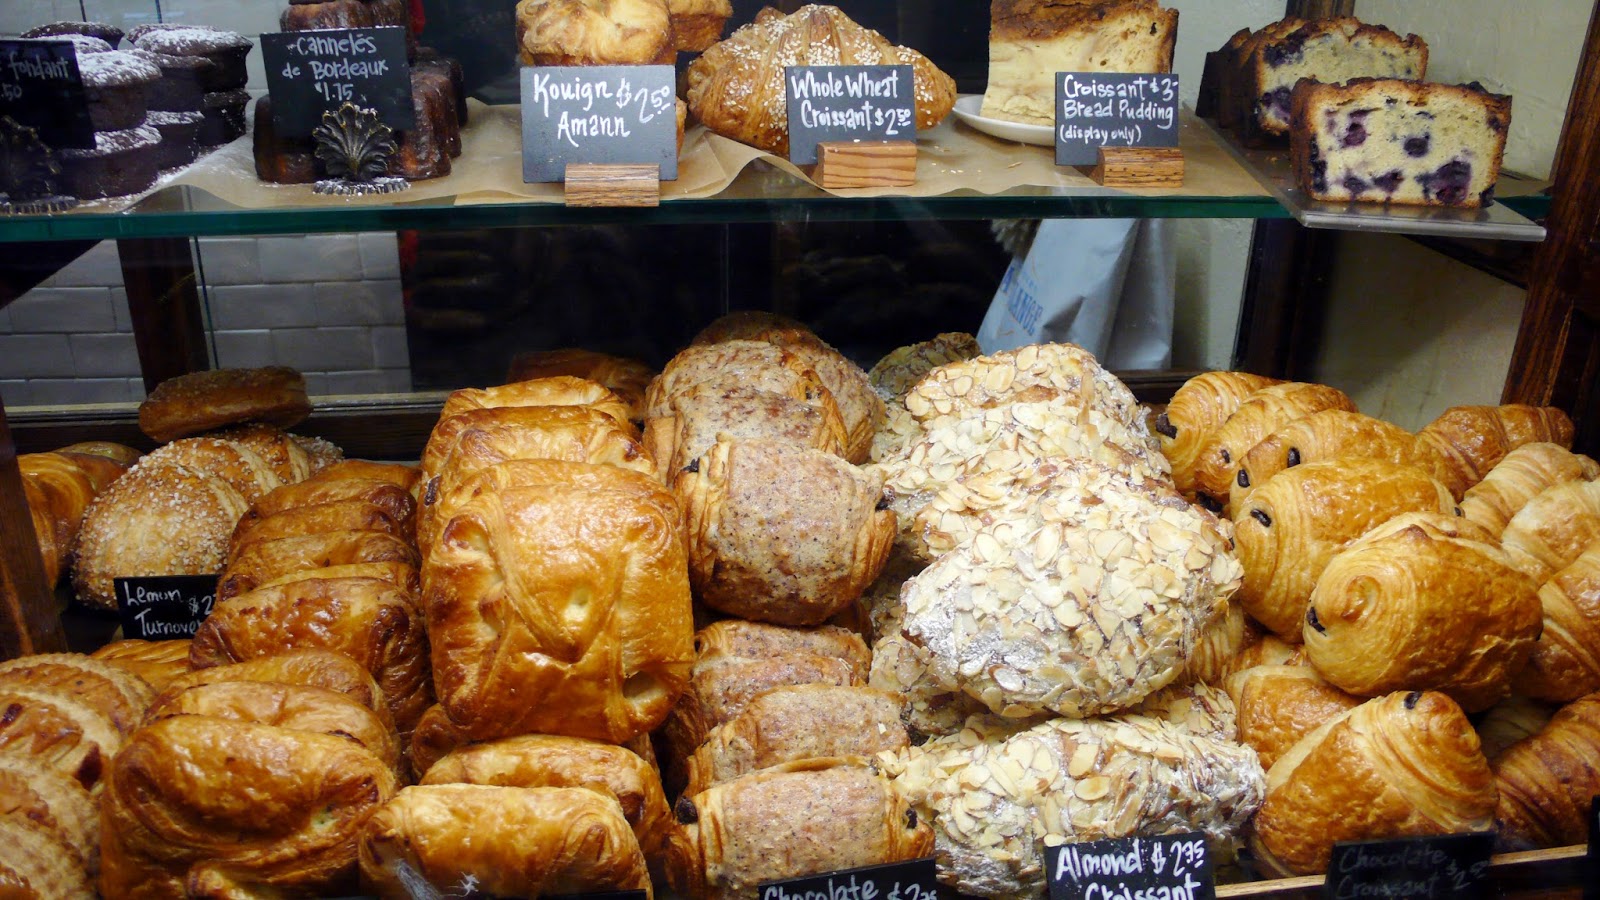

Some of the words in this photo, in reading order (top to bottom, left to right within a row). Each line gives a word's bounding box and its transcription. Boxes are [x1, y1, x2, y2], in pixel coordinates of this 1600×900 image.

[7, 50, 69, 80] fondant
[282, 62, 301, 79] de
[308, 57, 389, 80] Bordeaux
[533, 73, 613, 118] Kouign
[791, 70, 844, 99] Whole
[845, 69, 899, 98] Wheat
[1064, 74, 1148, 101] Croissant
[557, 111, 631, 147] Amann
[801, 99, 873, 131] Croissant
[1063, 98, 1113, 119] Bread
[1119, 98, 1173, 130] Pudding
[1060, 124, 1109, 146] (display
[1111, 124, 1142, 147] only)
[123, 581, 181, 606] Lemon
[1055, 838, 1143, 883] Almond
[1339, 844, 1447, 873] Chocolate
